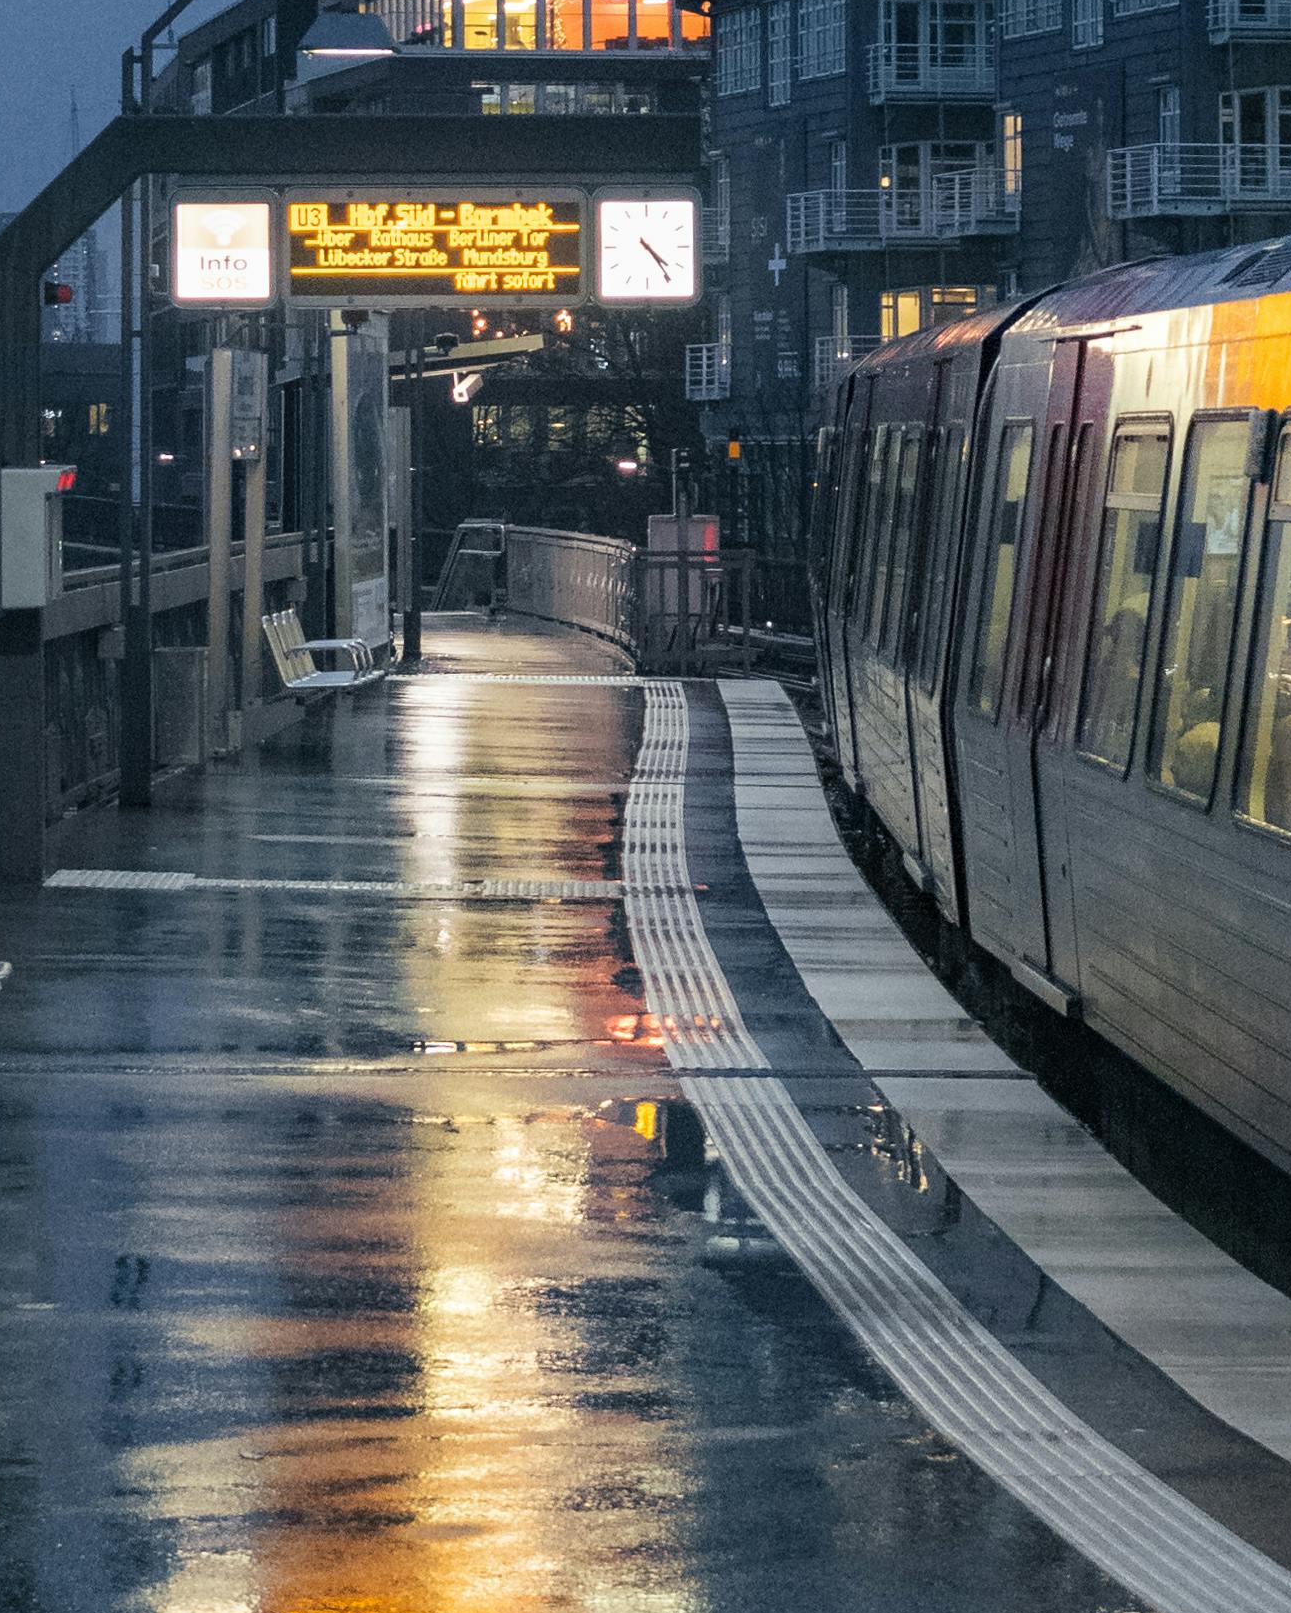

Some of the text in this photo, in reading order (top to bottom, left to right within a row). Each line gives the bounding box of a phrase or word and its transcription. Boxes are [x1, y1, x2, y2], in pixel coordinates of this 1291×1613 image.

[297, 207, 322, 227] U3
[459, 203, 554, 227] Barmbek
[370, 229, 434, 247] Rathaus
[449, 229, 517, 247] Berliner
[519, 229, 550, 247] Tor
[200, 255, 248, 271] Info
[319, 248, 549, 268] Lübecker Straße Mundsburg
[201, 276, 248, 291] SOS
[455, 271, 556, 290] fährt sofort
